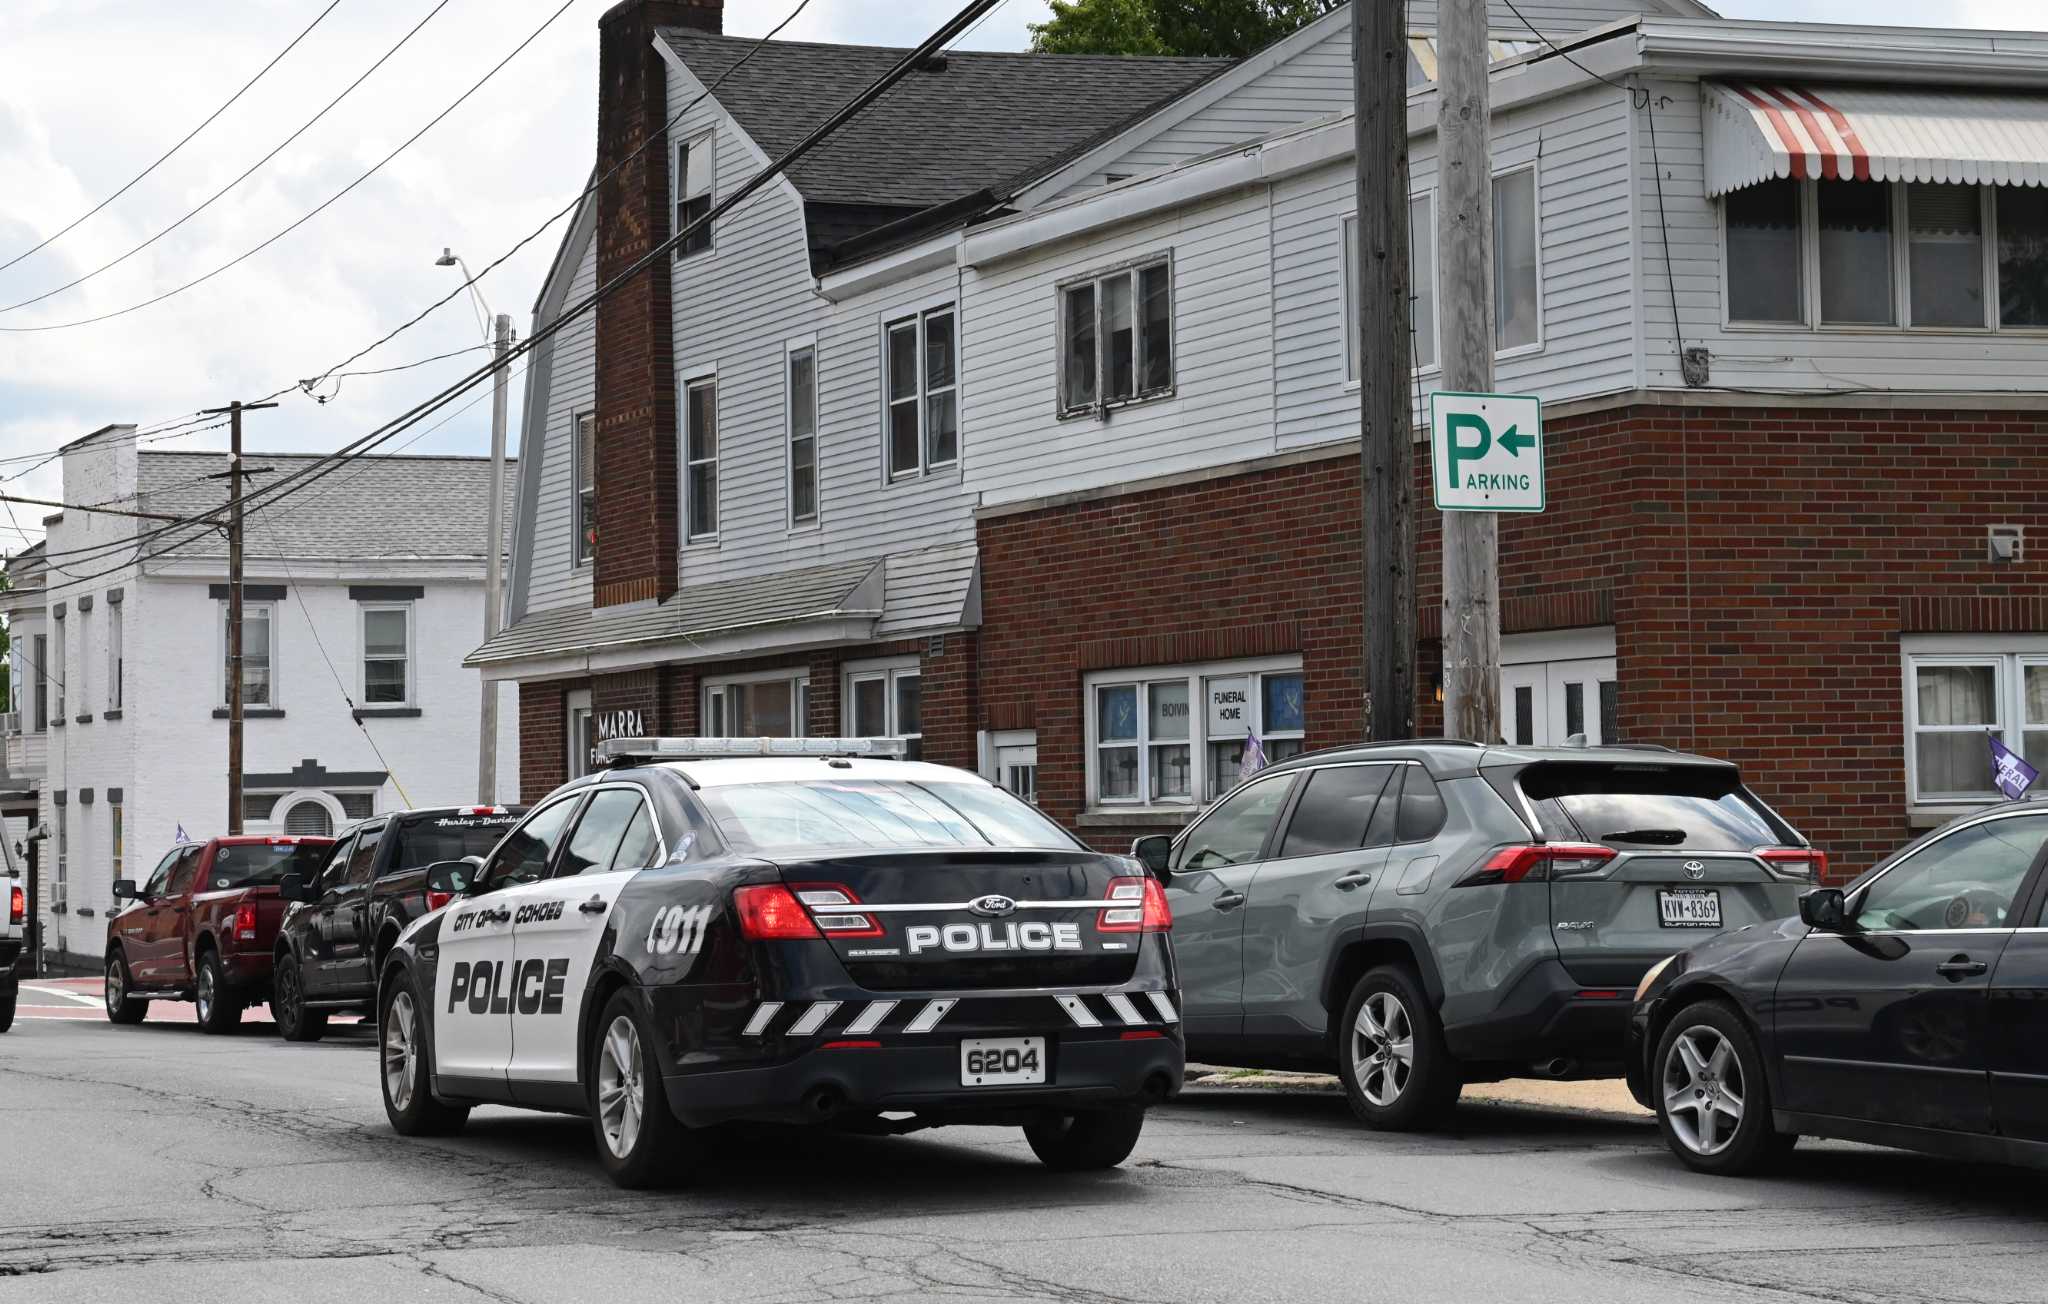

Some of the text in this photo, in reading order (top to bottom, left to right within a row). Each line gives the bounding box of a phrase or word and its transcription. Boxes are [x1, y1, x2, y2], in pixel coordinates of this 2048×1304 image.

[1214, 690, 1247, 704] FUNERAL
[598, 710, 644, 739] MARRA
[1219, 708, 1241, 720] HOME
[984, 898, 1007, 909] Ford
[454, 912, 477, 932] CITY
[656, 905, 714, 954] 911
[906, 922, 1083, 954] POLICE
[448, 958, 570, 1014] POLICE
[967, 1048, 1039, 1074] 6204
